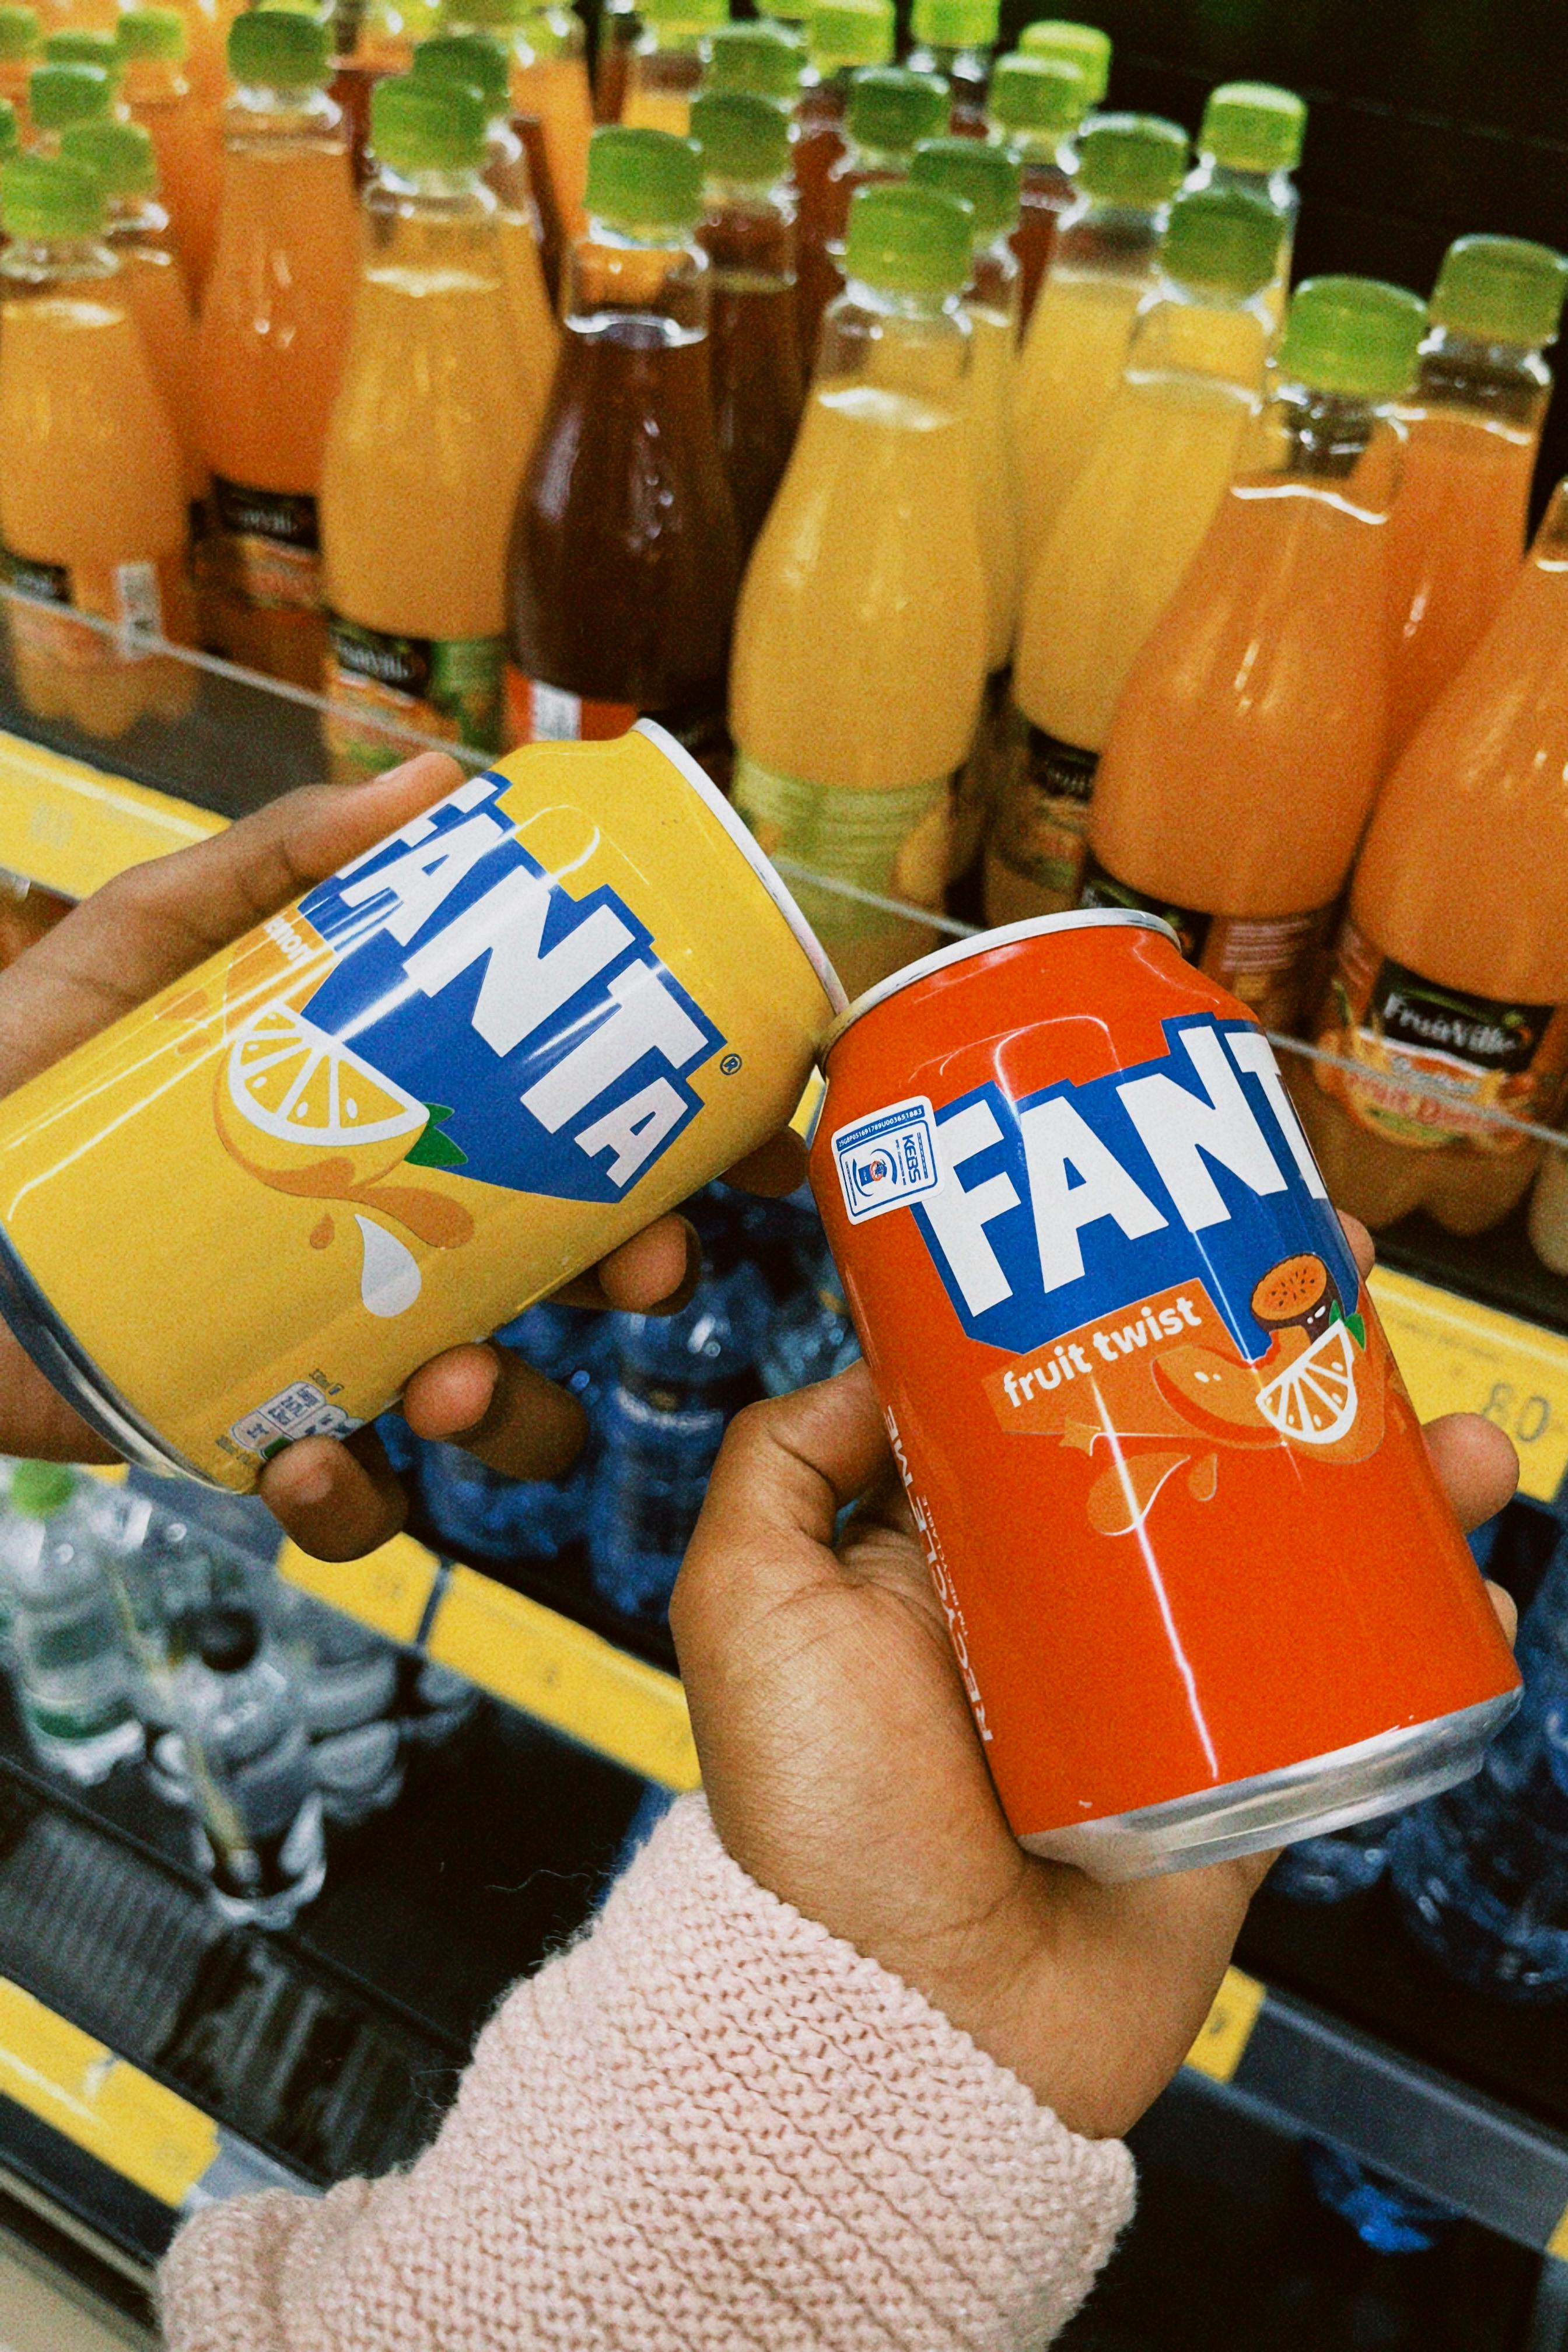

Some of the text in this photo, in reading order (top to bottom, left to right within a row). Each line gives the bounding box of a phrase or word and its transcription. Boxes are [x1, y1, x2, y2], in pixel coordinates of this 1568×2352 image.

[335, 777, 708, 1188] FANTA
[902, 1133, 922, 1184] KEBS
[1003, 1296, 1202, 1407] fruit twist
[914, 1495, 993, 1741] RECYCLE
